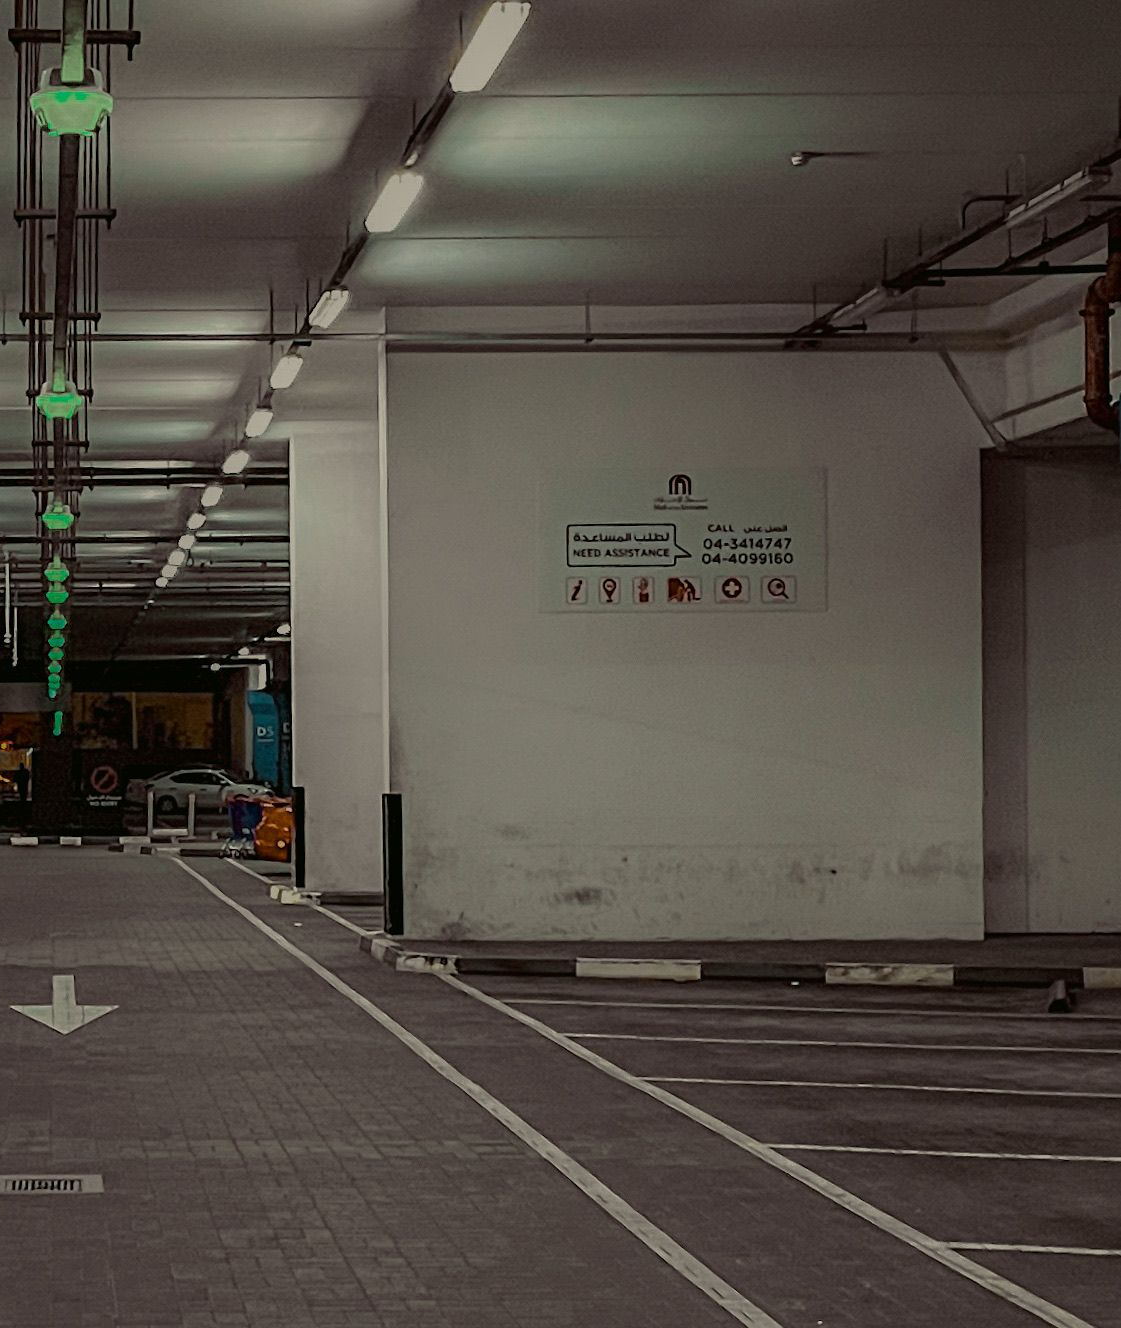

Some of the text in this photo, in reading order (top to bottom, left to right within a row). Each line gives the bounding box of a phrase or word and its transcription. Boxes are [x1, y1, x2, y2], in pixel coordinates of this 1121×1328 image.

[708, 524, 734, 532] CALL
[703, 538, 792, 549] 04-3414747
[573, 548, 670, 557] NEED ASSISTANCE
[702, 553, 793, 564] 04-4099160
